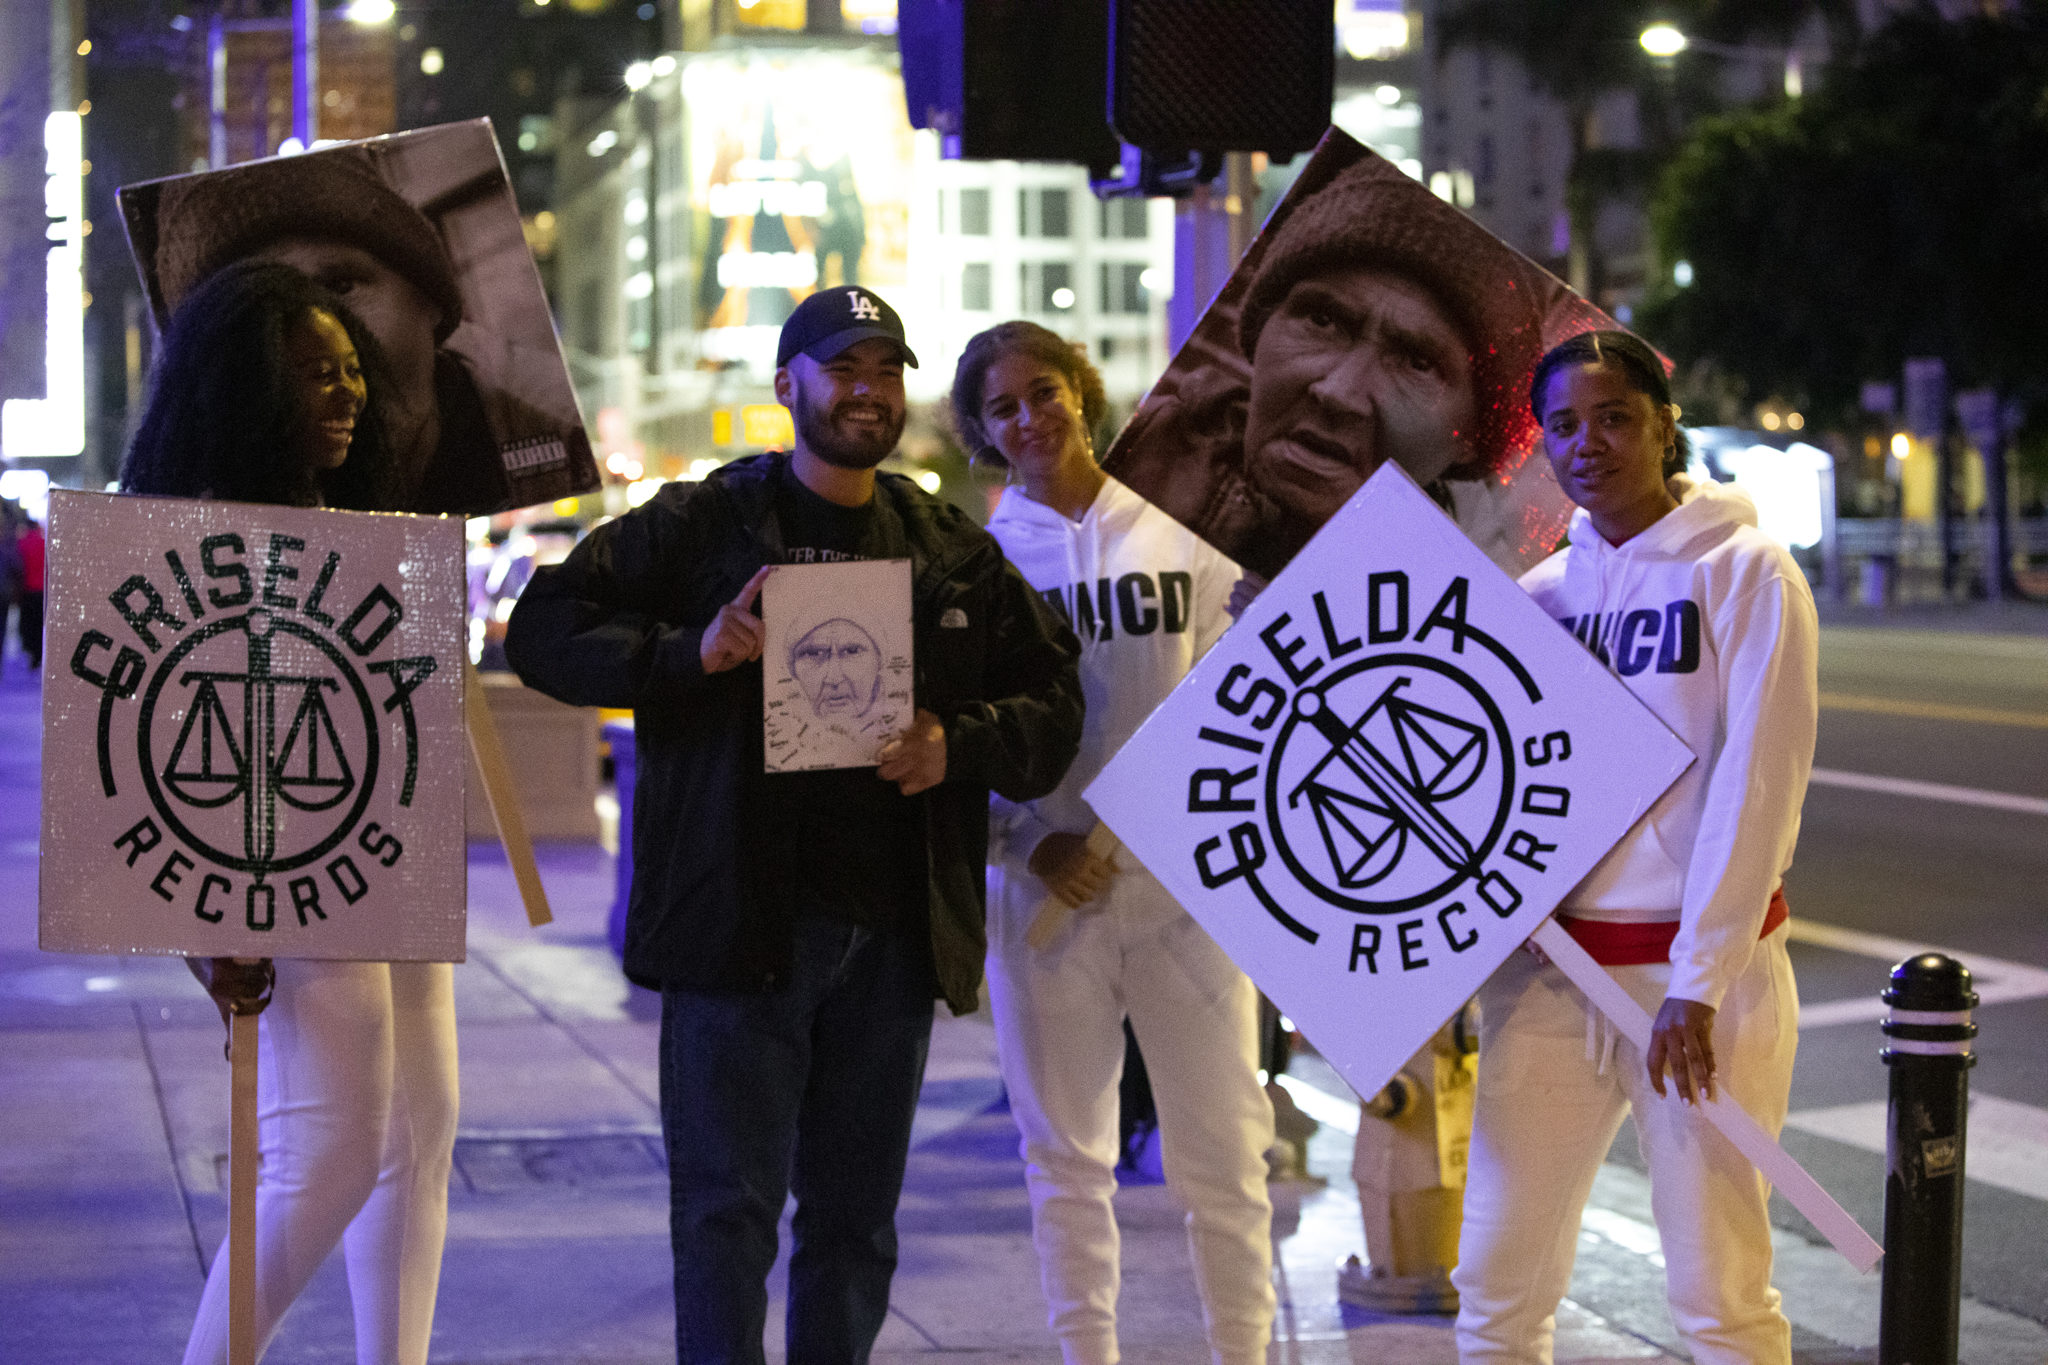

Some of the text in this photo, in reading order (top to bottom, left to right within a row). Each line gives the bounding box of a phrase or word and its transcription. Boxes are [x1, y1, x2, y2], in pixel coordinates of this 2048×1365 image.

[847, 291, 880, 321] LA
[70, 533, 438, 713] GRISELDA
[1187, 570, 1470, 890] GRISELDA
[113, 815, 403, 932] RECORDS
[1348, 730, 1572, 975] RECORDS
